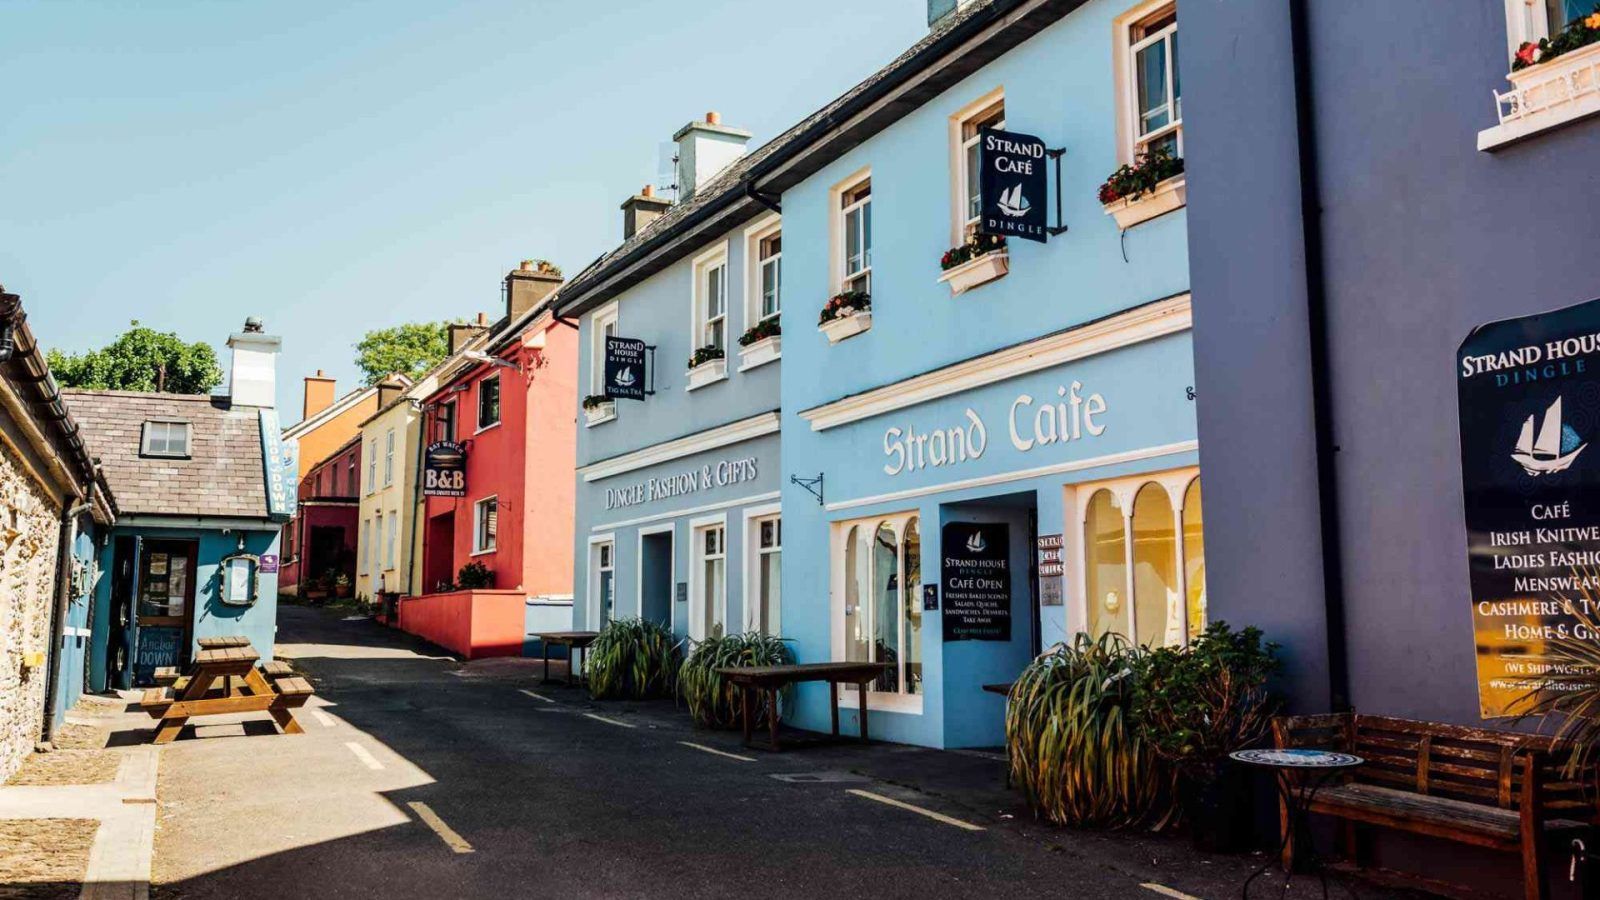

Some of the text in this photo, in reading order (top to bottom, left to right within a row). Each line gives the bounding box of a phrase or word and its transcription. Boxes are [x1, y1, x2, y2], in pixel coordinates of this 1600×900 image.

[986, 136, 1044, 158] STRAND
[994, 156, 1033, 175] CAFÉ
[989, 219, 1042, 234] DINGLE
[608, 341, 644, 351] STRAND
[614, 349, 639, 357] HOUSE
[609, 356, 642, 364] DINGLE
[1462, 345, 1541, 378] STRAND
[1496, 359, 1586, 387] DINGLE
[883, 380, 1108, 476] Strand Caife
[428, 442, 440, 452] BAY
[425, 469, 465, 490] B&B
[605, 457, 758, 510] DINGLE FASHION & GIFTS
[272, 473, 286, 512] DOWN
[1531, 500, 1571, 520] CAFÉ
[1490, 531, 1531, 546] IRISH
[945, 557, 1006, 569] STRAND HOUSE
[1494, 554, 1545, 569] LADIES
[949, 577, 1003, 589] CAFÉ OPEN
[1478, 601, 1559, 616] CASHMERE
[1505, 624, 1552, 640] HOME
[1557, 623, 1570, 640] &
[140, 651, 173, 666] DOWN
